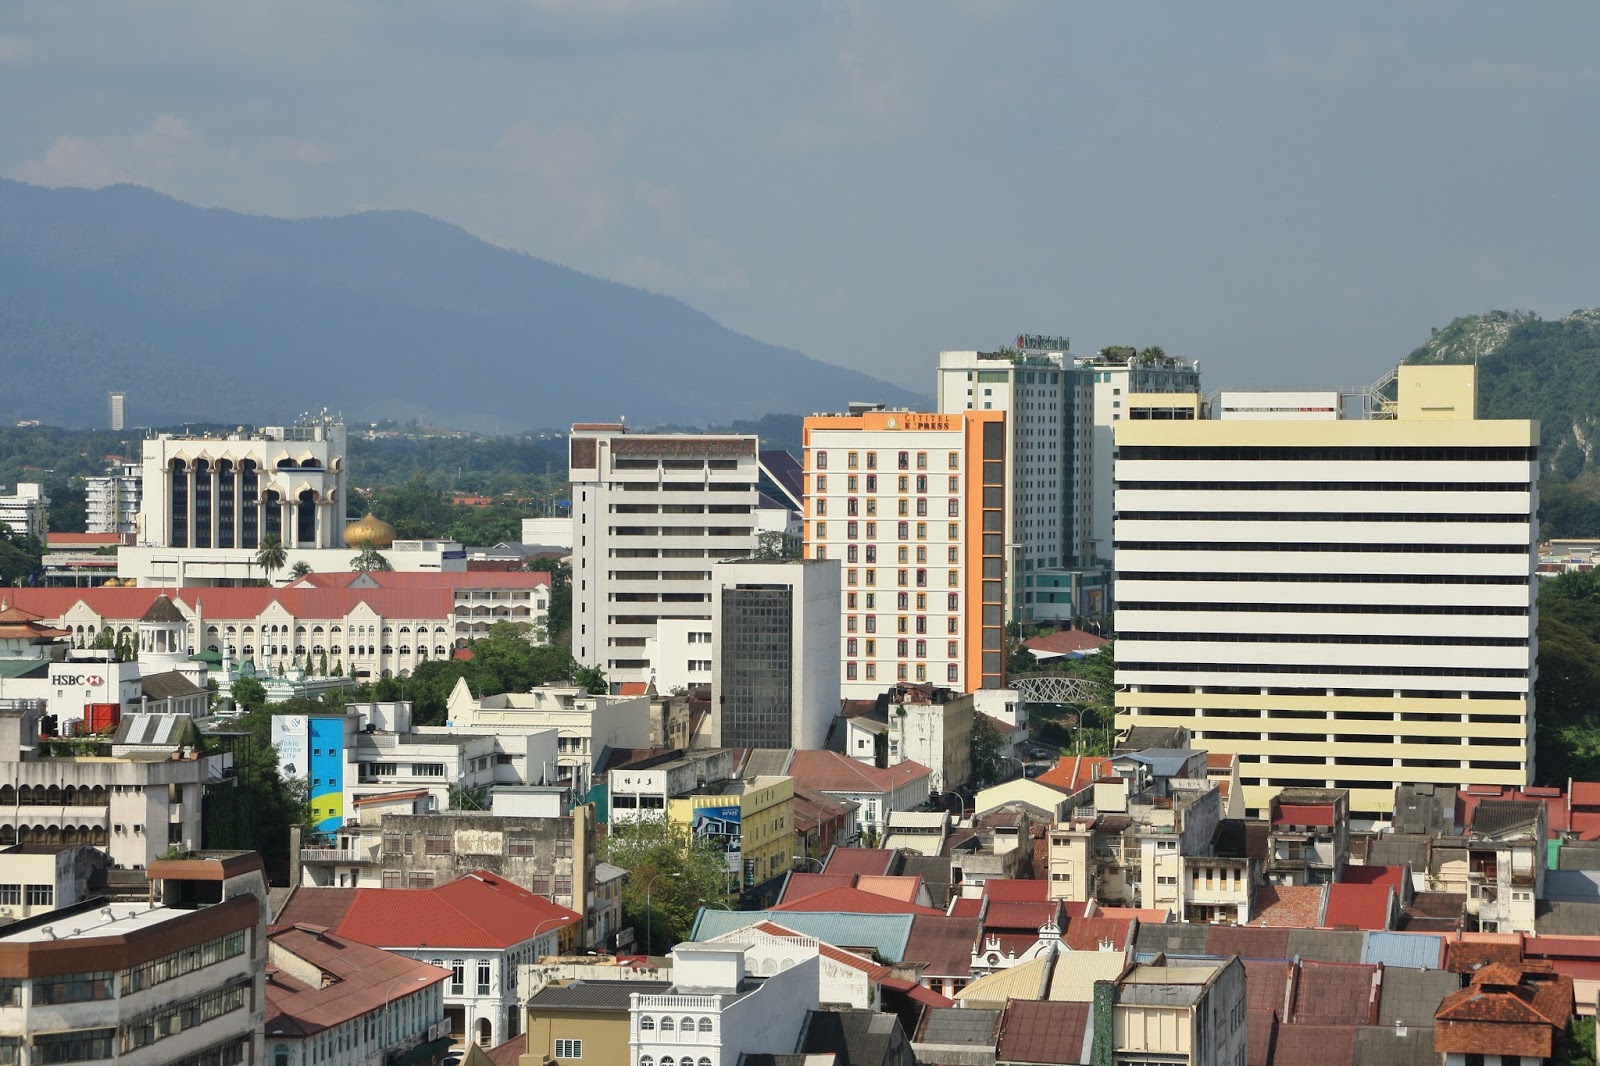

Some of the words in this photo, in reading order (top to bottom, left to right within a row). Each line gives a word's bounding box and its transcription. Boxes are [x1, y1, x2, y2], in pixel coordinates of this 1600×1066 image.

[904, 414, 950, 422] CITITEL
[905, 422, 950, 430] EXPRESS
[52, 674, 86, 686] HSBC
